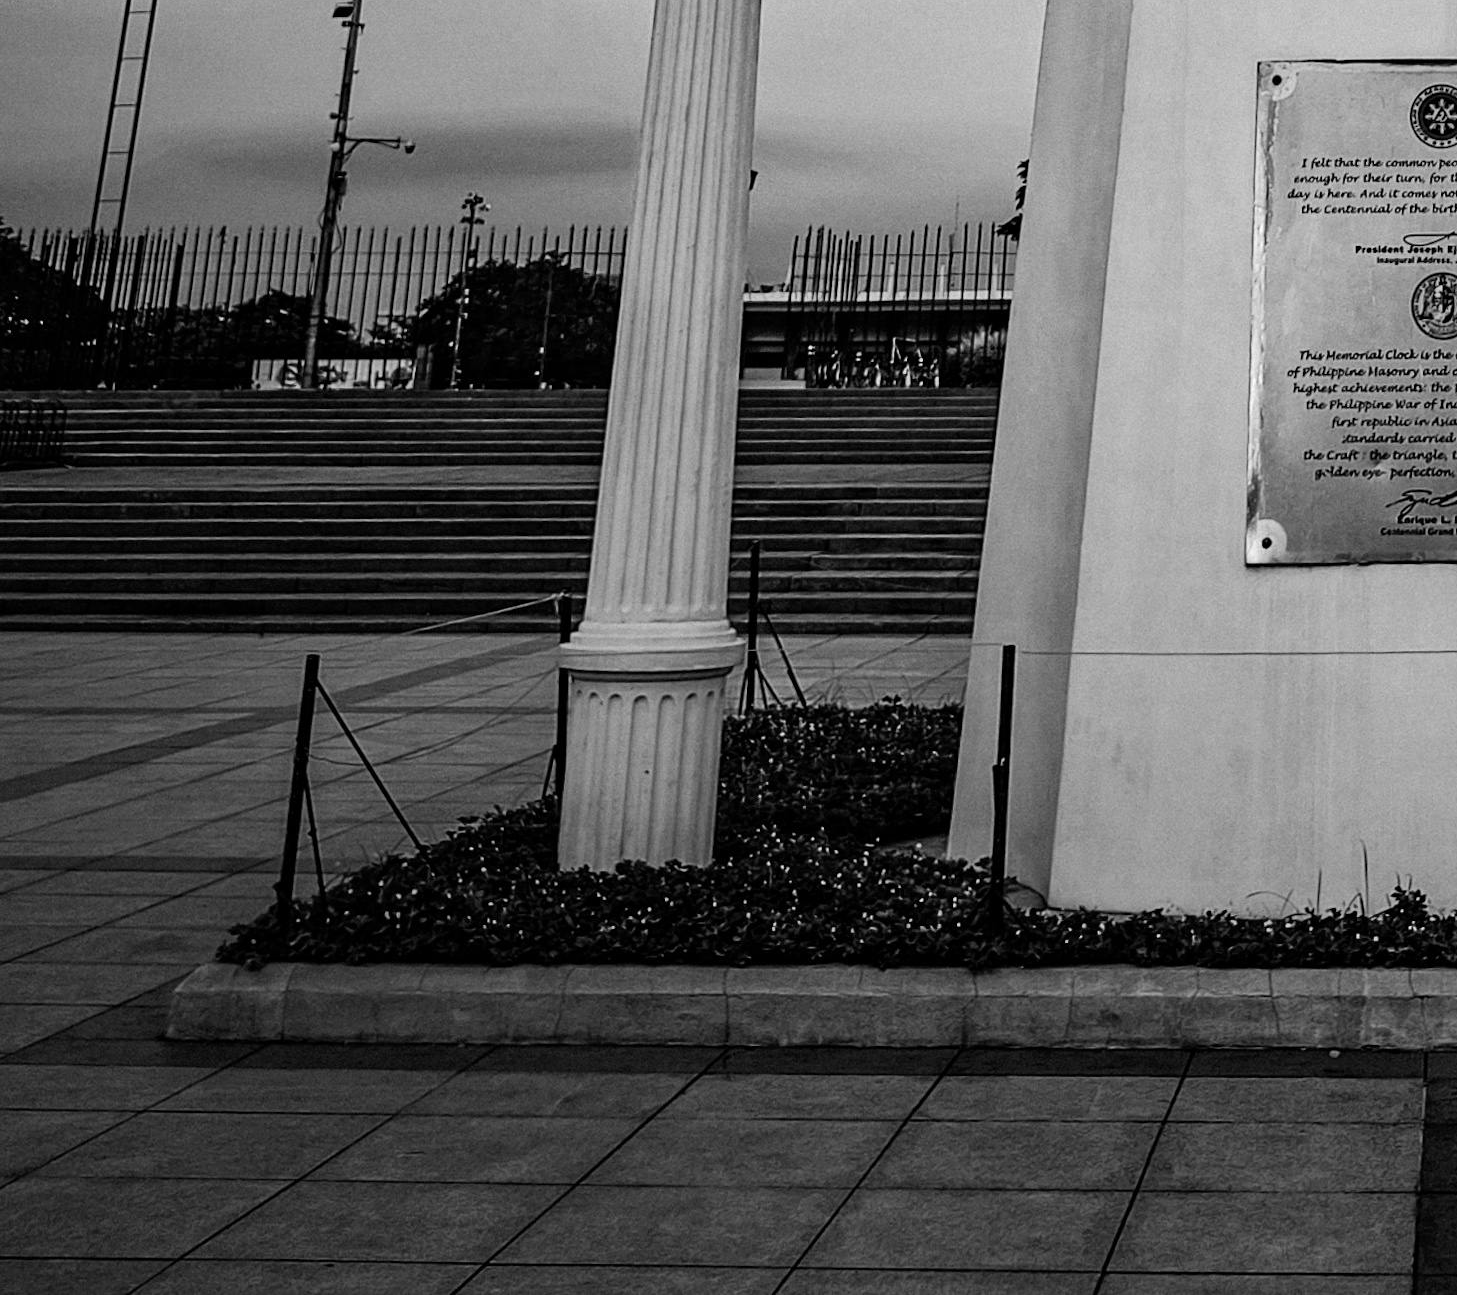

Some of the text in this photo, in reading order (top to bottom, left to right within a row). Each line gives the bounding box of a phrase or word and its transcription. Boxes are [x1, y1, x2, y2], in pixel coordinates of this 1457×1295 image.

[1302, 157, 1307, 169] I
[1311, 156, 1331, 171] felt
[1334, 156, 1361, 169] that
[1364, 156, 1383, 169] the
[1385, 159, 1436, 169] common
[1294, 172, 1340, 187] enough
[1342, 172, 1360, 186] for
[1363, 171, 1392, 184] their
[1430, 171, 1447, 186] for
[1287, 187, 1310, 203] day
[1314, 189, 1325, 200] is
[1360, 187, 1386, 199] And
[1389, 188, 1400, 199] it
[1402, 190, 1438, 200] comes
[1302, 203, 1321, 215] the
[1324, 202, 1392, 215] Centennial
[1395, 202, 1408, 216] of
[1410, 202, 1429, 215] the
[1356, 244, 1403, 255] President
[1407, 244, 1443, 256] Joseph
[1300, 349, 1324, 362] This
[1326, 348, 1384, 362] Memorial
[1386, 348, 1418, 361] Clock
[1421, 349, 1431, 361] is
[1433, 348, 1453, 360] the
[1287, 365, 1301, 380] of
[1302, 365, 1366, 381] Philippine
[1368, 365, 1419, 380] Masonry
[1423, 364, 1449, 377] and
[1293, 381, 1338, 398] highest
[1431, 381, 1451, 393] the
[1306, 398, 1327, 411] the
[1330, 398, 1393, 414] Philippine
[1396, 398, 1421, 410] War
[1424, 397, 1438, 412] of
[1332, 415, 1358, 430] first
[1361, 415, 1412, 431] republic
[1414, 416, 1429, 427] in
[1408, 431, 1456, 444] carried
[1304, 448, 1325, 461] the
[1369, 448, 1390, 461] the
